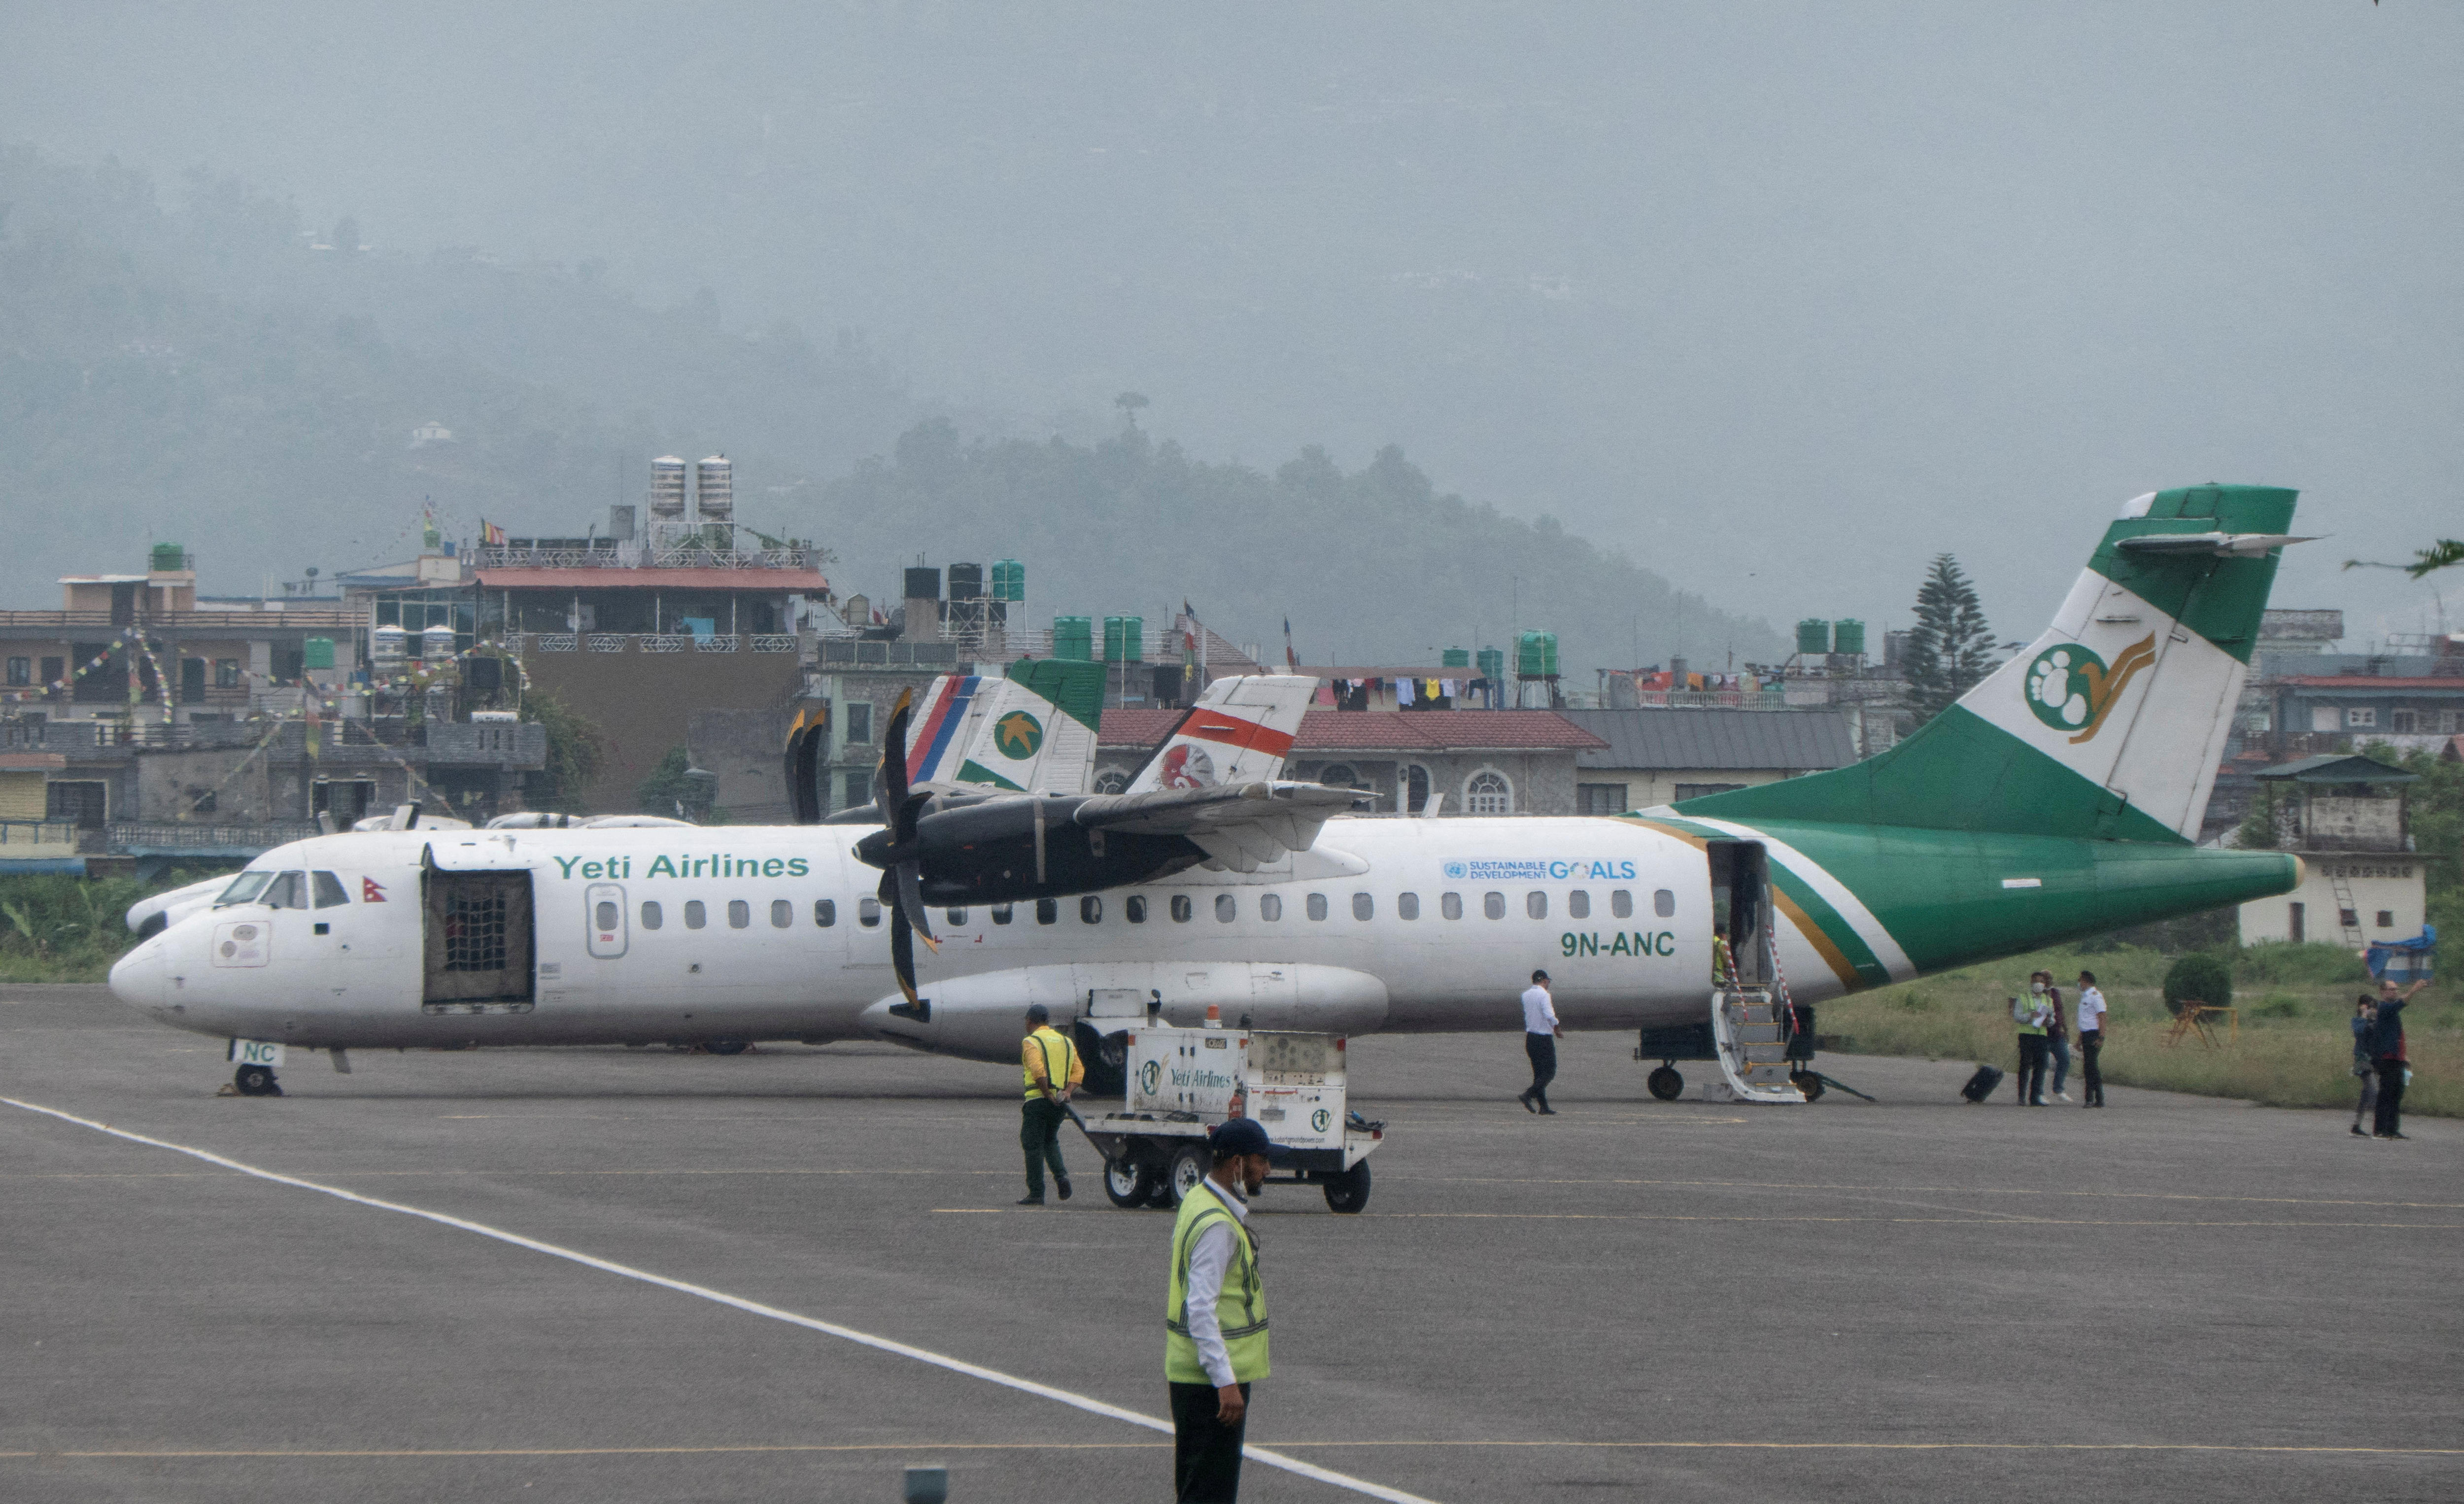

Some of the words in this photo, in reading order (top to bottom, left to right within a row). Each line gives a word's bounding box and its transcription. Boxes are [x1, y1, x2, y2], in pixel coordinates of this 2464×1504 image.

[553, 855, 631, 879] Yeti
[646, 854, 810, 879] Airlines
[1470, 861, 1546, 870] SUSTAINABLE
[1470, 871, 1547, 879] DEVELOPMENT
[1561, 931, 1675, 957] 9N-ANC
[244, 1042, 275, 1062] NC
[1171, 1068, 1191, 1087] Yeti
[1193, 1069, 1231, 1088] Airlines
